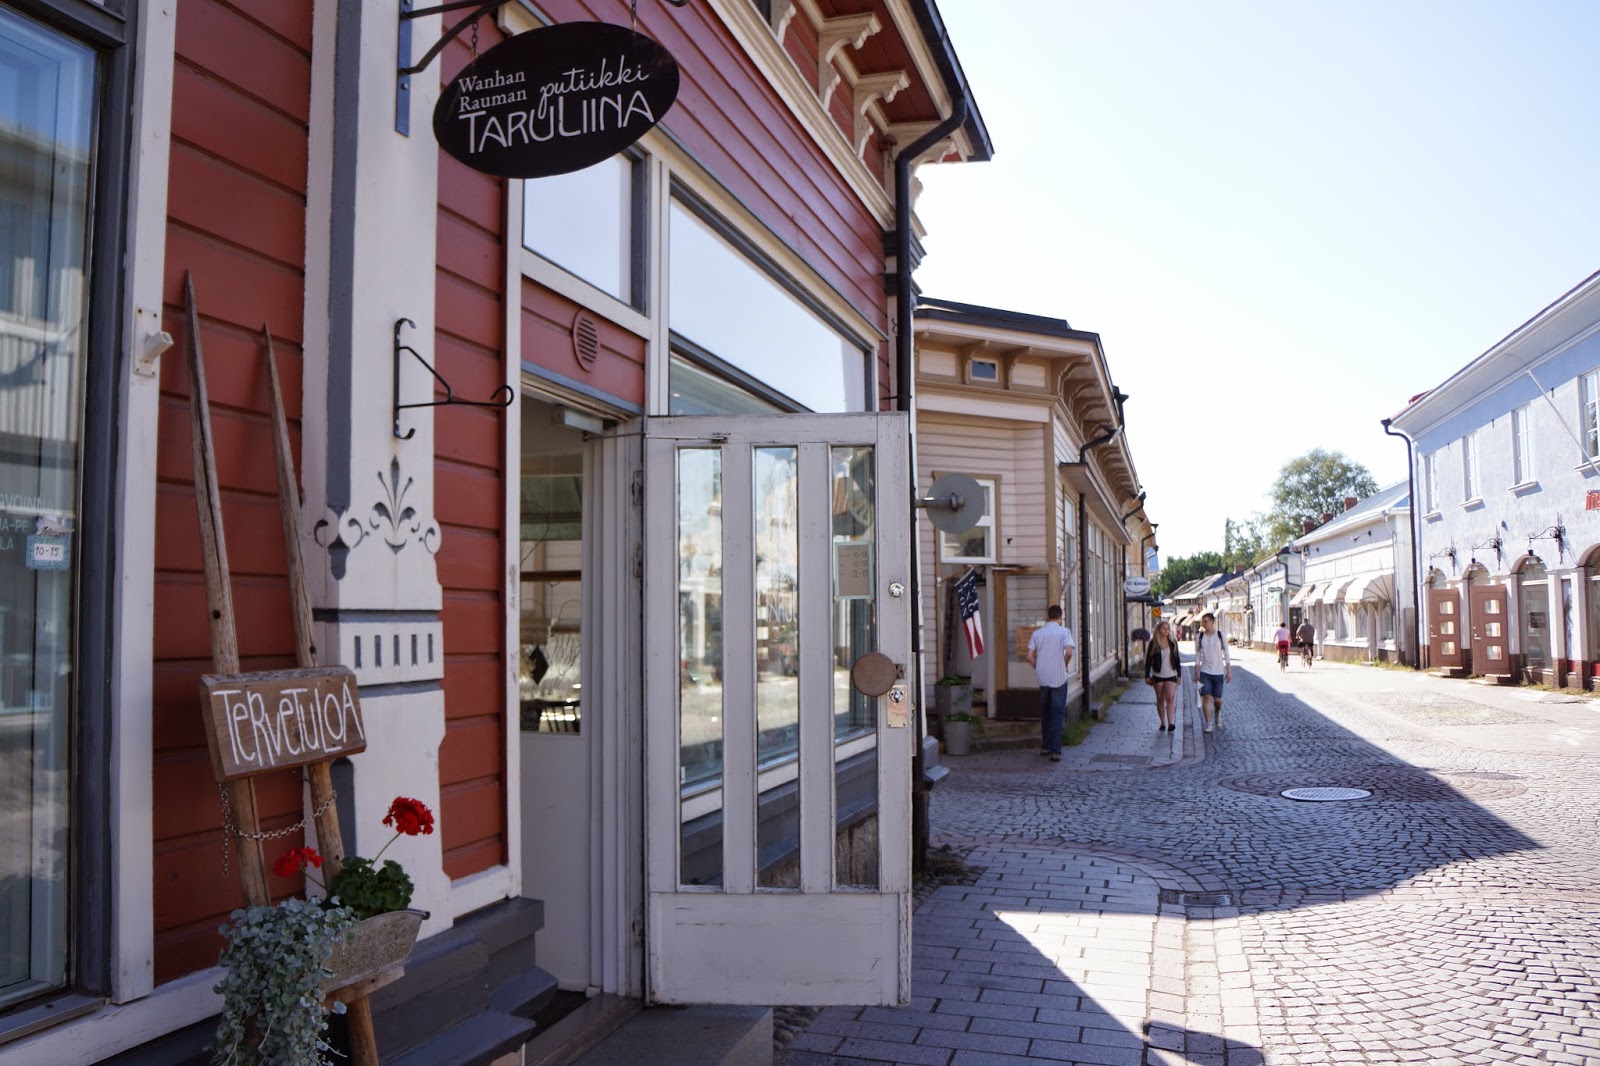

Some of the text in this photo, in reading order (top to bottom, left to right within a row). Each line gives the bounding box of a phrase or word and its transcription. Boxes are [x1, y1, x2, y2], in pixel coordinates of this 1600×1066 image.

[458, 70, 526, 94] Wanhan
[537, 54, 650, 120] putiikki
[458, 89, 528, 113] Rauman
[458, 90, 655, 154] TARULIINA
[35, 545, 61, 557] 10-15
